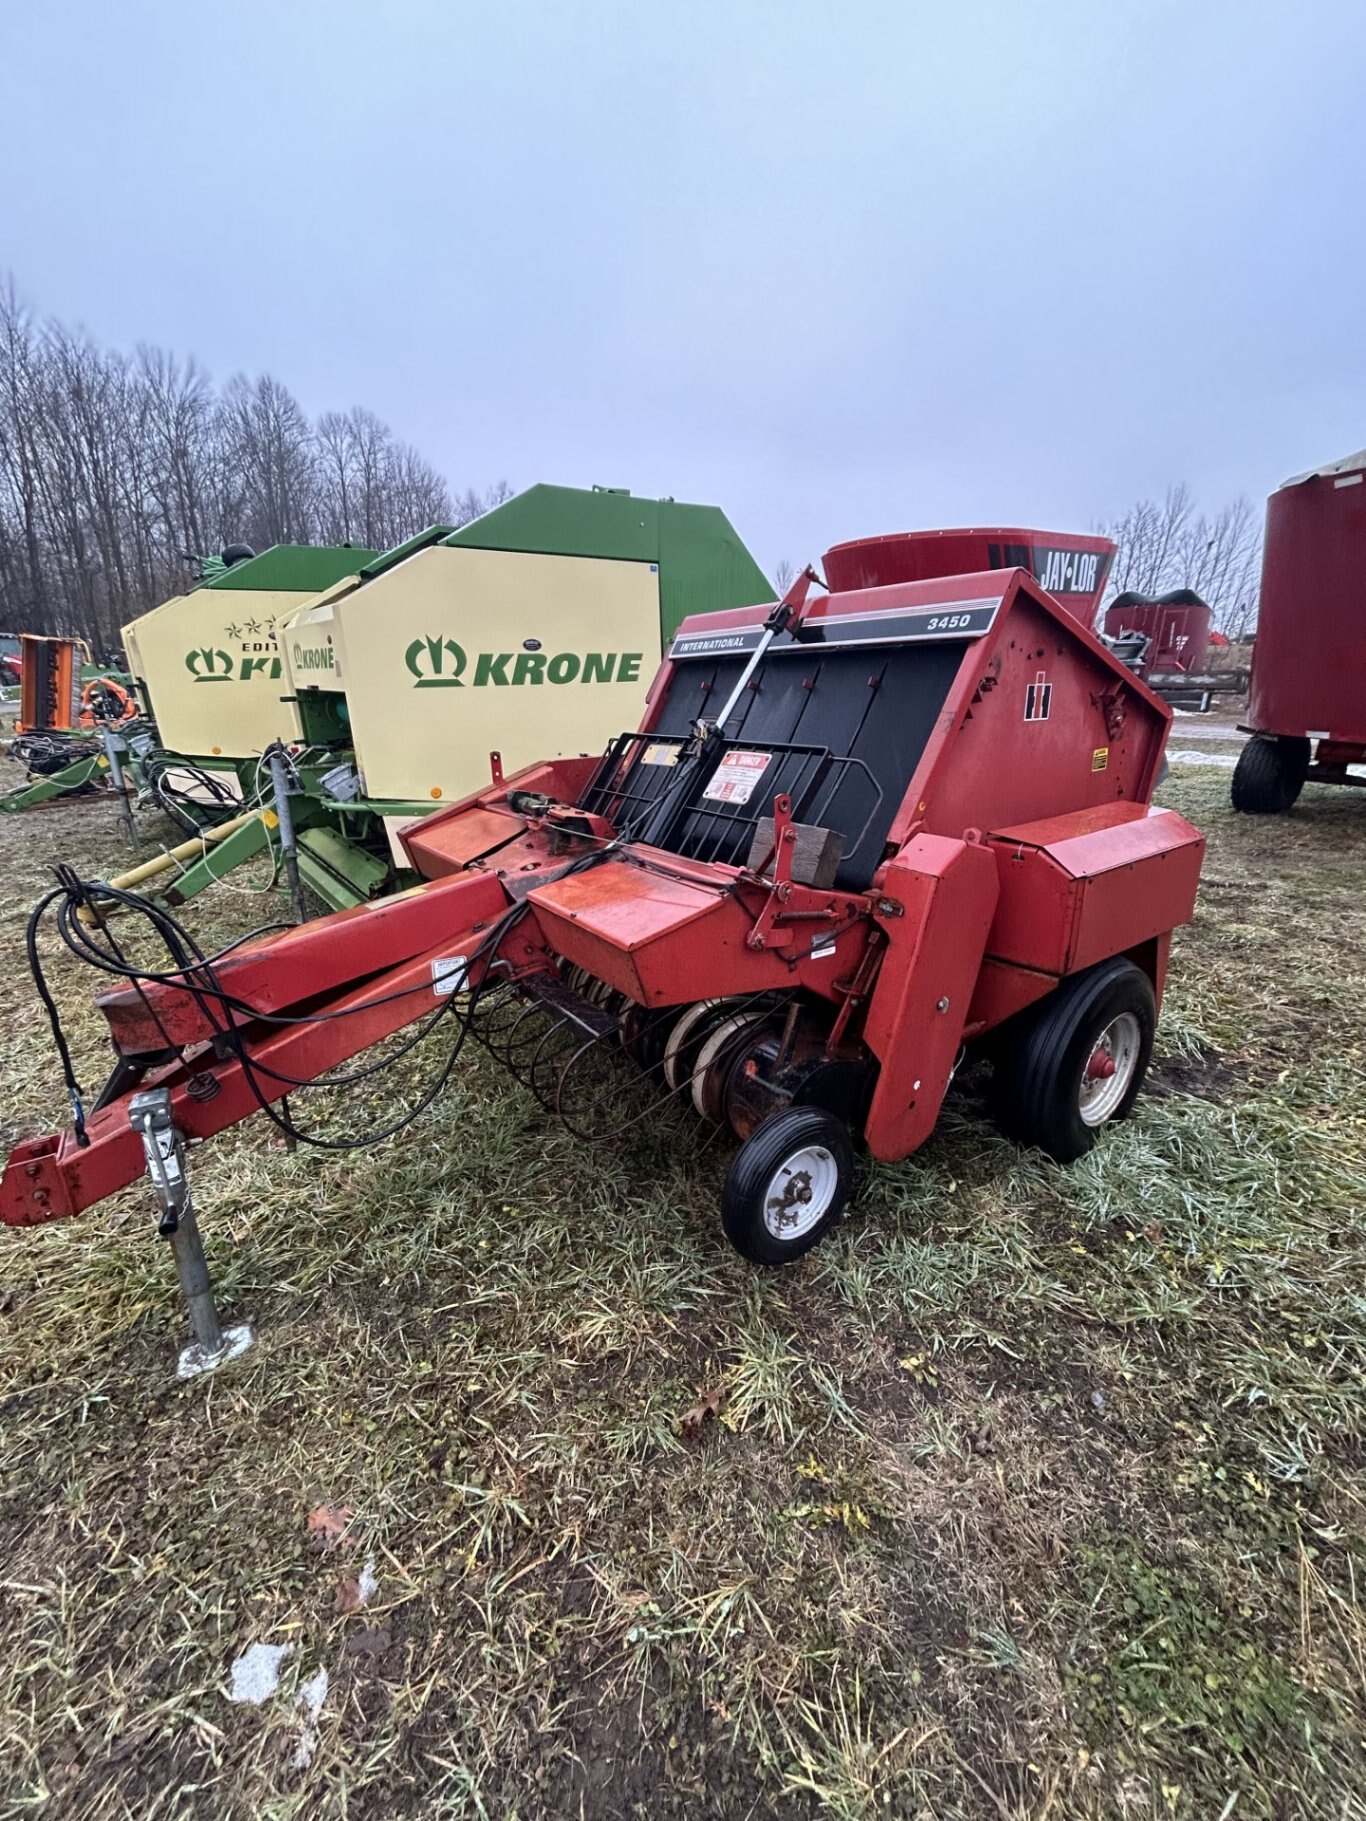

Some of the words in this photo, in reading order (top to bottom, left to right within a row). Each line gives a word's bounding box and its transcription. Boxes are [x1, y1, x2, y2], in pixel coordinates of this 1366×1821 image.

[927, 614, 971, 630] 3450
[680, 637, 744, 652] INTERNATIONAL
[303, 647, 334, 669] KRONE
[473, 653, 643, 687] KRONE
